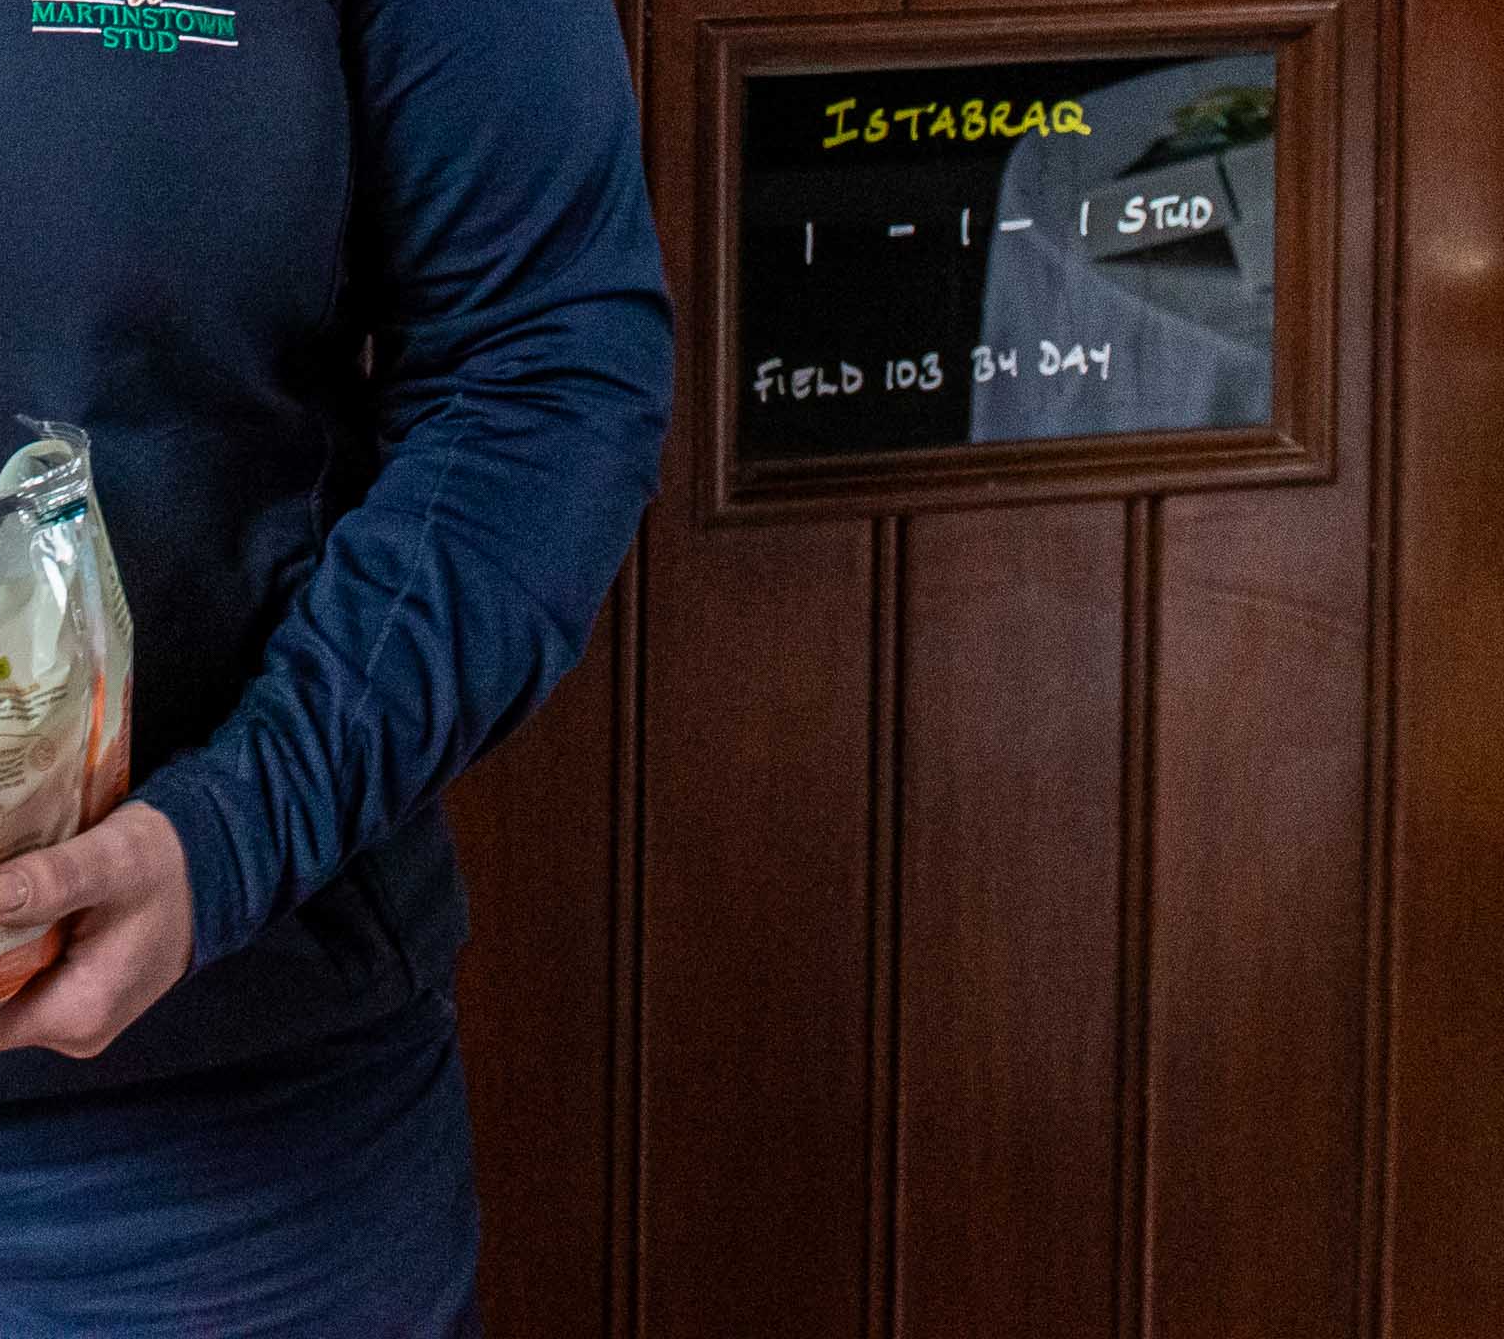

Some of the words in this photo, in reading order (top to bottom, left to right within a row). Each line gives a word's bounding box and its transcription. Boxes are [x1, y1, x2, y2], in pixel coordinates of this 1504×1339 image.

[32, 1, 235, 37] MARTINSTOWN
[103, 26, 179, 54] STUD
[822, 97, 1092, 149] ISTABRAQ
[1117, 194, 1214, 235] STUD
[753, 356, 864, 403] FIELD
[885, 352, 944, 391] 103
[1039, 339, 1111, 381] DAY
